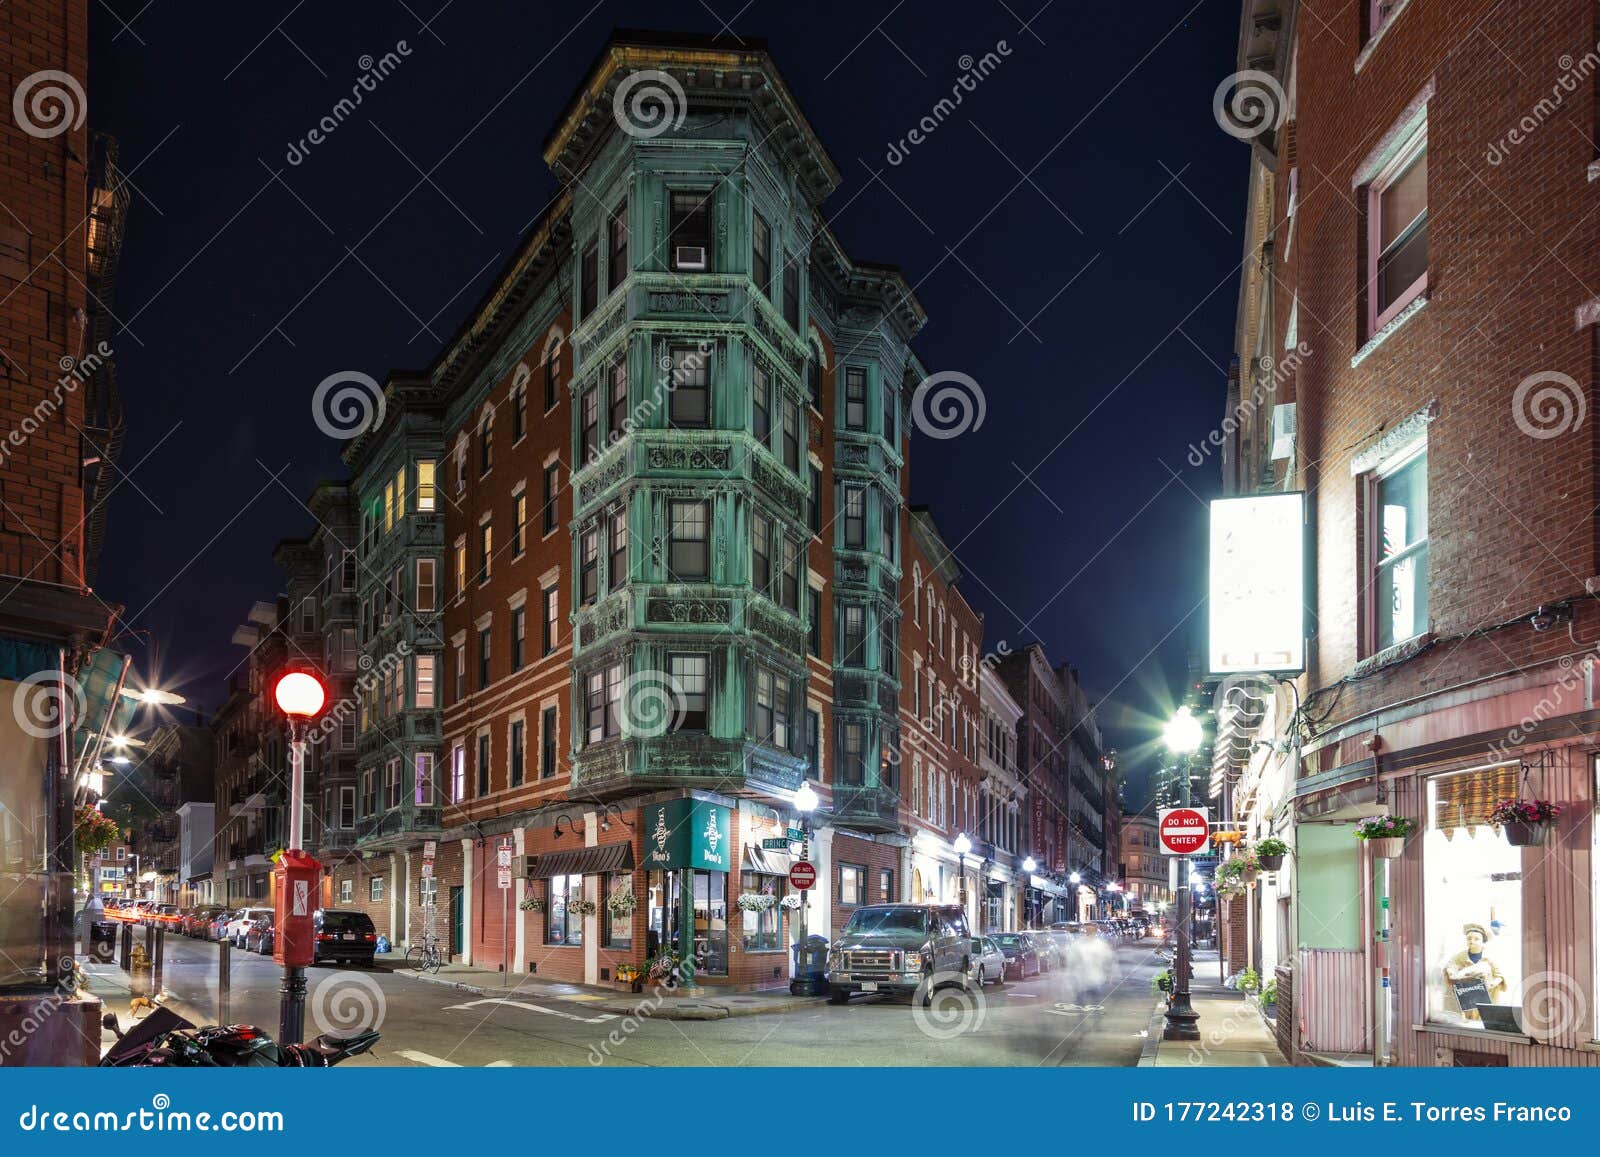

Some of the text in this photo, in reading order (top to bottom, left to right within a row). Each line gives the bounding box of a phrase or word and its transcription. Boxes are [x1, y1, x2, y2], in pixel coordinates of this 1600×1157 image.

[1168, 818, 1199, 826] DO NOT
[764, 840, 788, 849] PRINC
[1171, 837, 1197, 845] ENTER
